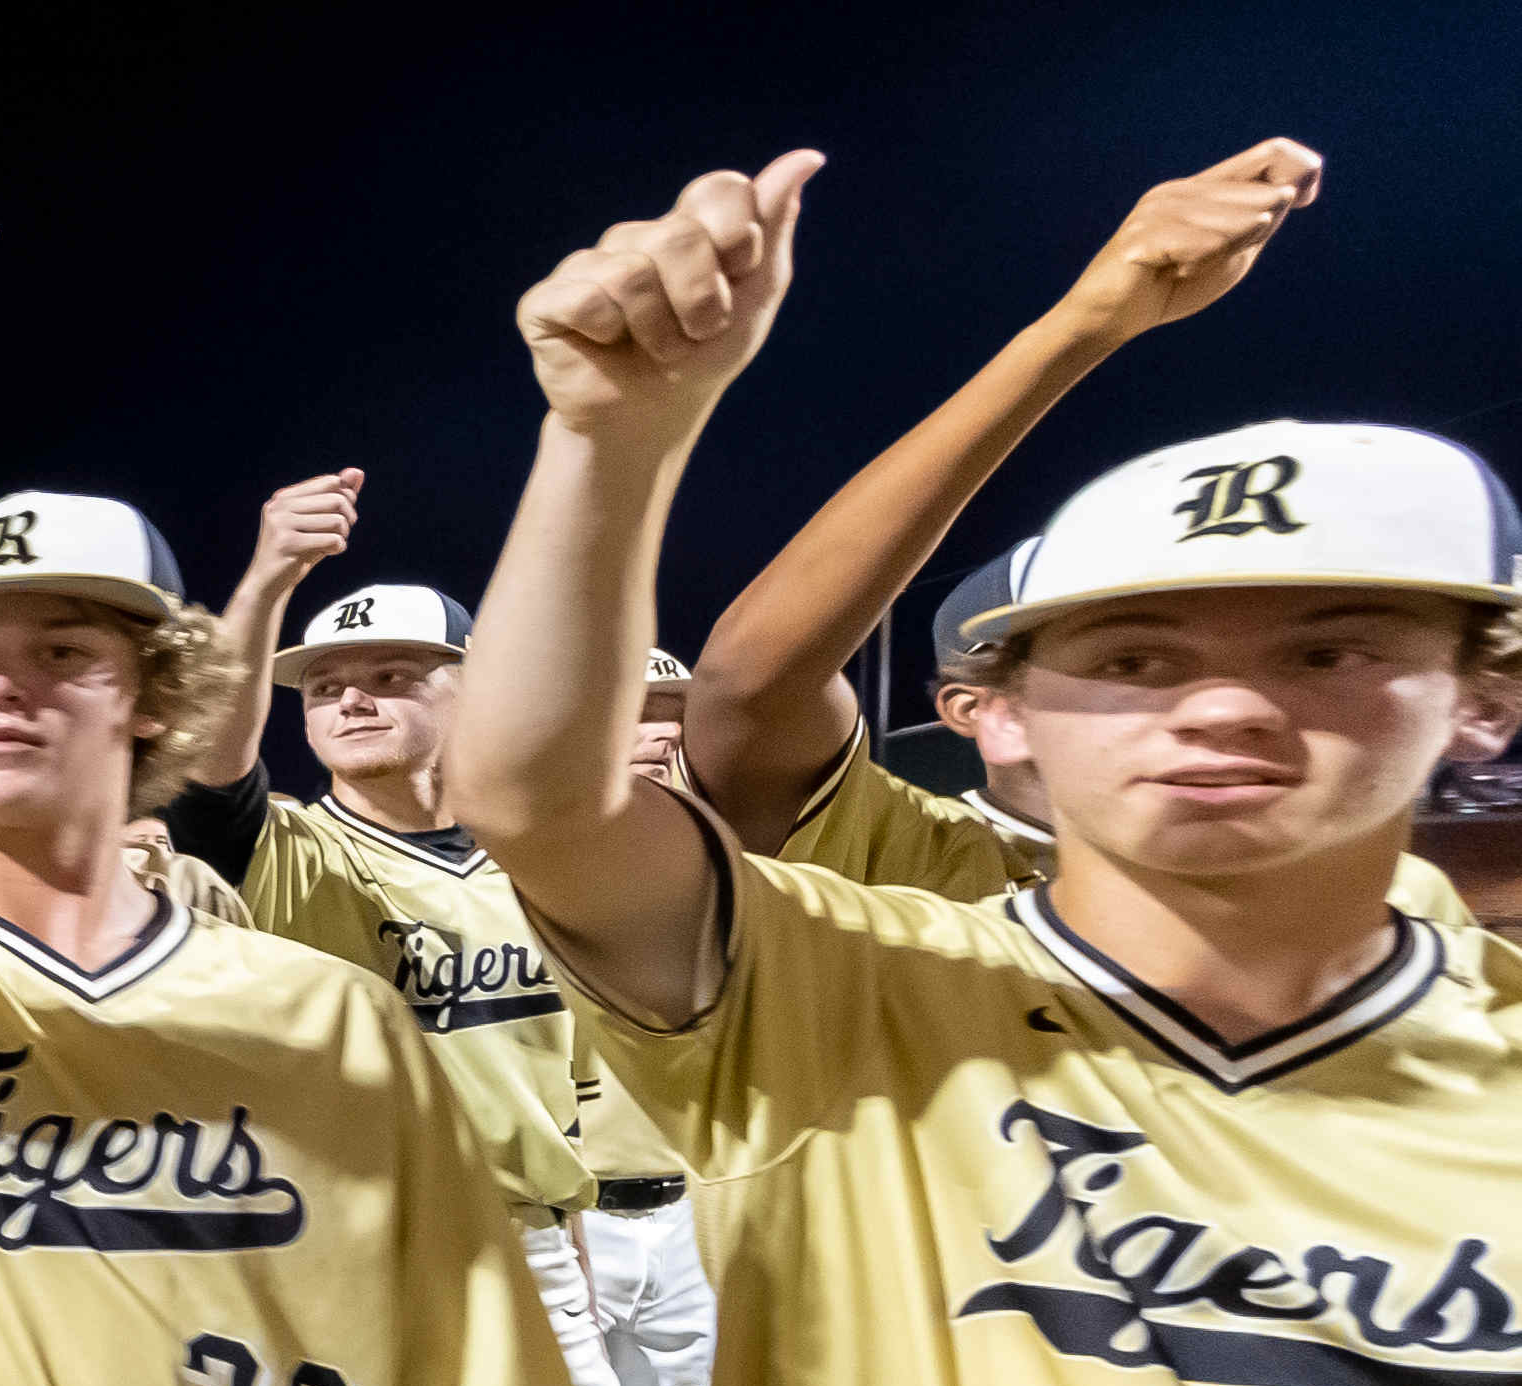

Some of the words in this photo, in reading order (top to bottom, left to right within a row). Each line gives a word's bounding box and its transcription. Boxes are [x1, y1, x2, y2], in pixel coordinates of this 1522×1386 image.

[1172, 453, 1308, 544] R
[333, 597, 375, 633] R
[378, 920, 565, 1034] Tiger
